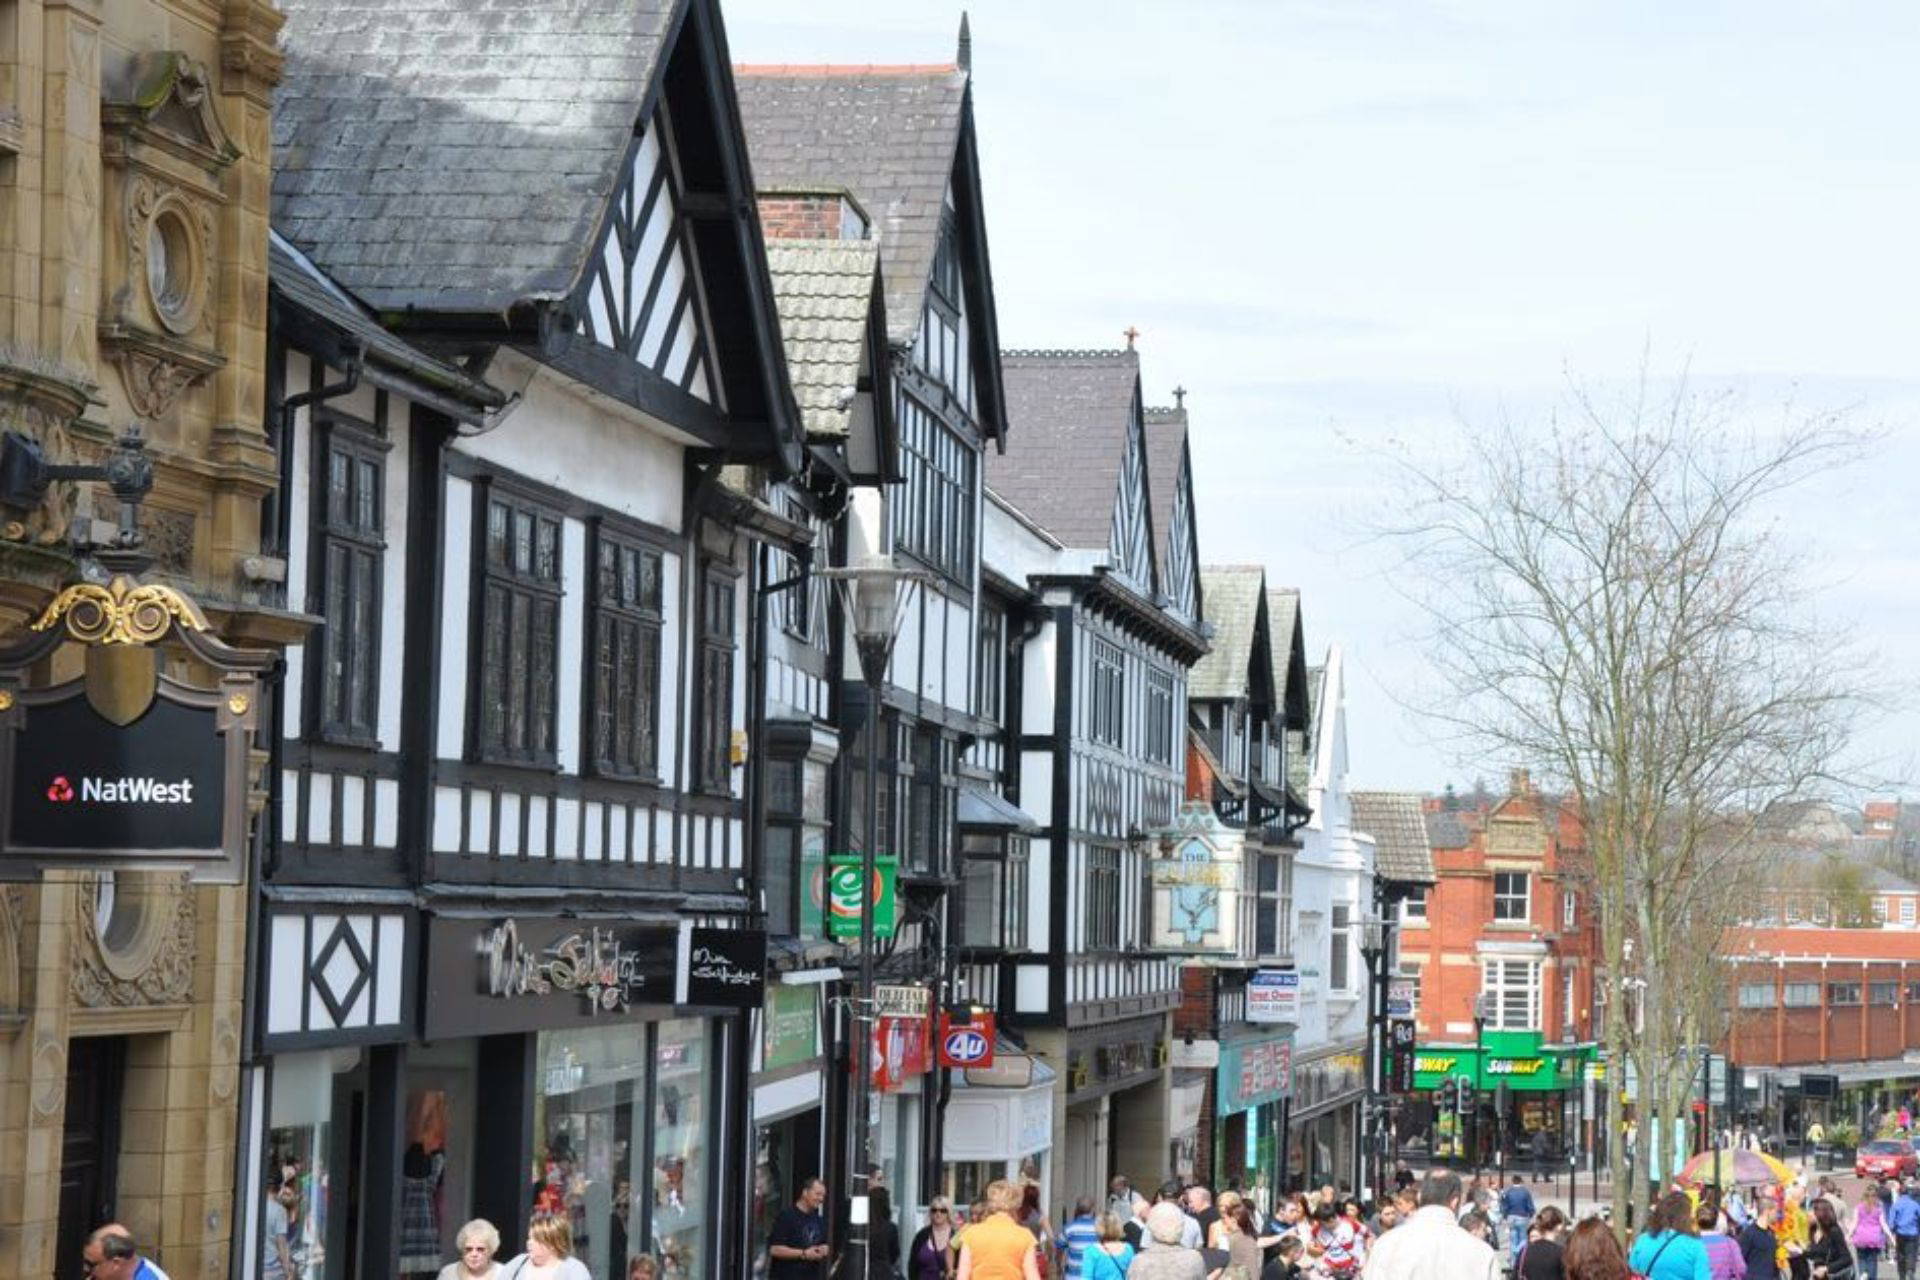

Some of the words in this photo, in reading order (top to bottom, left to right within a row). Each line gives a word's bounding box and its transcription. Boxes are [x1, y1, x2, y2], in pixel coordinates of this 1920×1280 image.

[82, 777, 193, 803] NatWest
[691, 965, 761, 985] Selfridge
[1414, 1058, 1456, 1073] BWAY
[1487, 1060, 1544, 1074] SUBWAY
